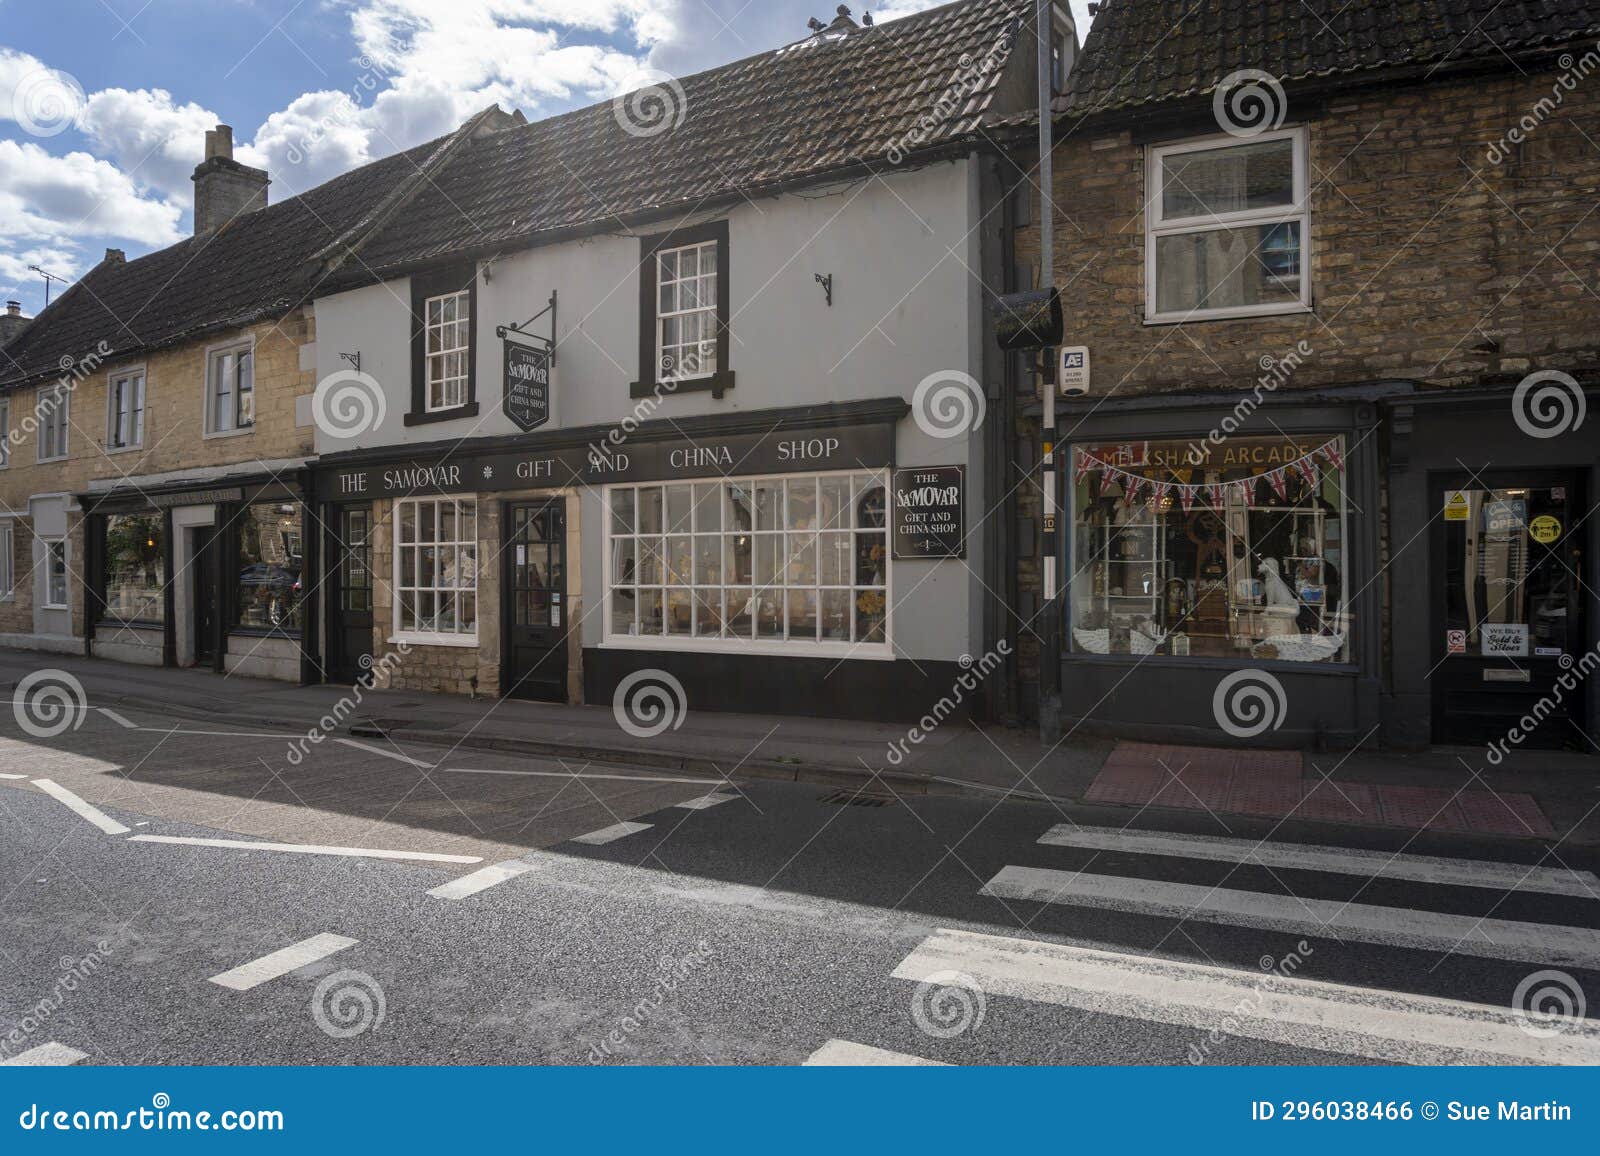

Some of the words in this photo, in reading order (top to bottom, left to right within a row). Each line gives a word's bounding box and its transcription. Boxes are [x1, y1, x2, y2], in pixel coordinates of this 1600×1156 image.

[520, 353, 536, 364] THE
[509, 361, 547, 384] SAMOVAR
[514, 384, 528, 394] GIFT
[530, 387, 542, 398] AND
[511, 395, 529, 406] CHINA
[530, 398, 546, 409] SHOP
[1224, 445, 1309, 464] ARCADE
[339, 472, 367, 493] THE
[383, 465, 460, 489] SAMOVAR
[516, 460, 555, 478] GIFT
[590, 453, 629, 473] AND
[670, 445, 732, 468] CHINA
[777, 438, 839, 460] SHOP
[914, 474, 938, 483] THE
[897, 486, 958, 507] SAMOVAR
[905, 513, 928, 522] GIFT
[931, 512, 951, 522] AND
[900, 525, 929, 534] CHINA
[931, 523, 957, 533] SHOP
